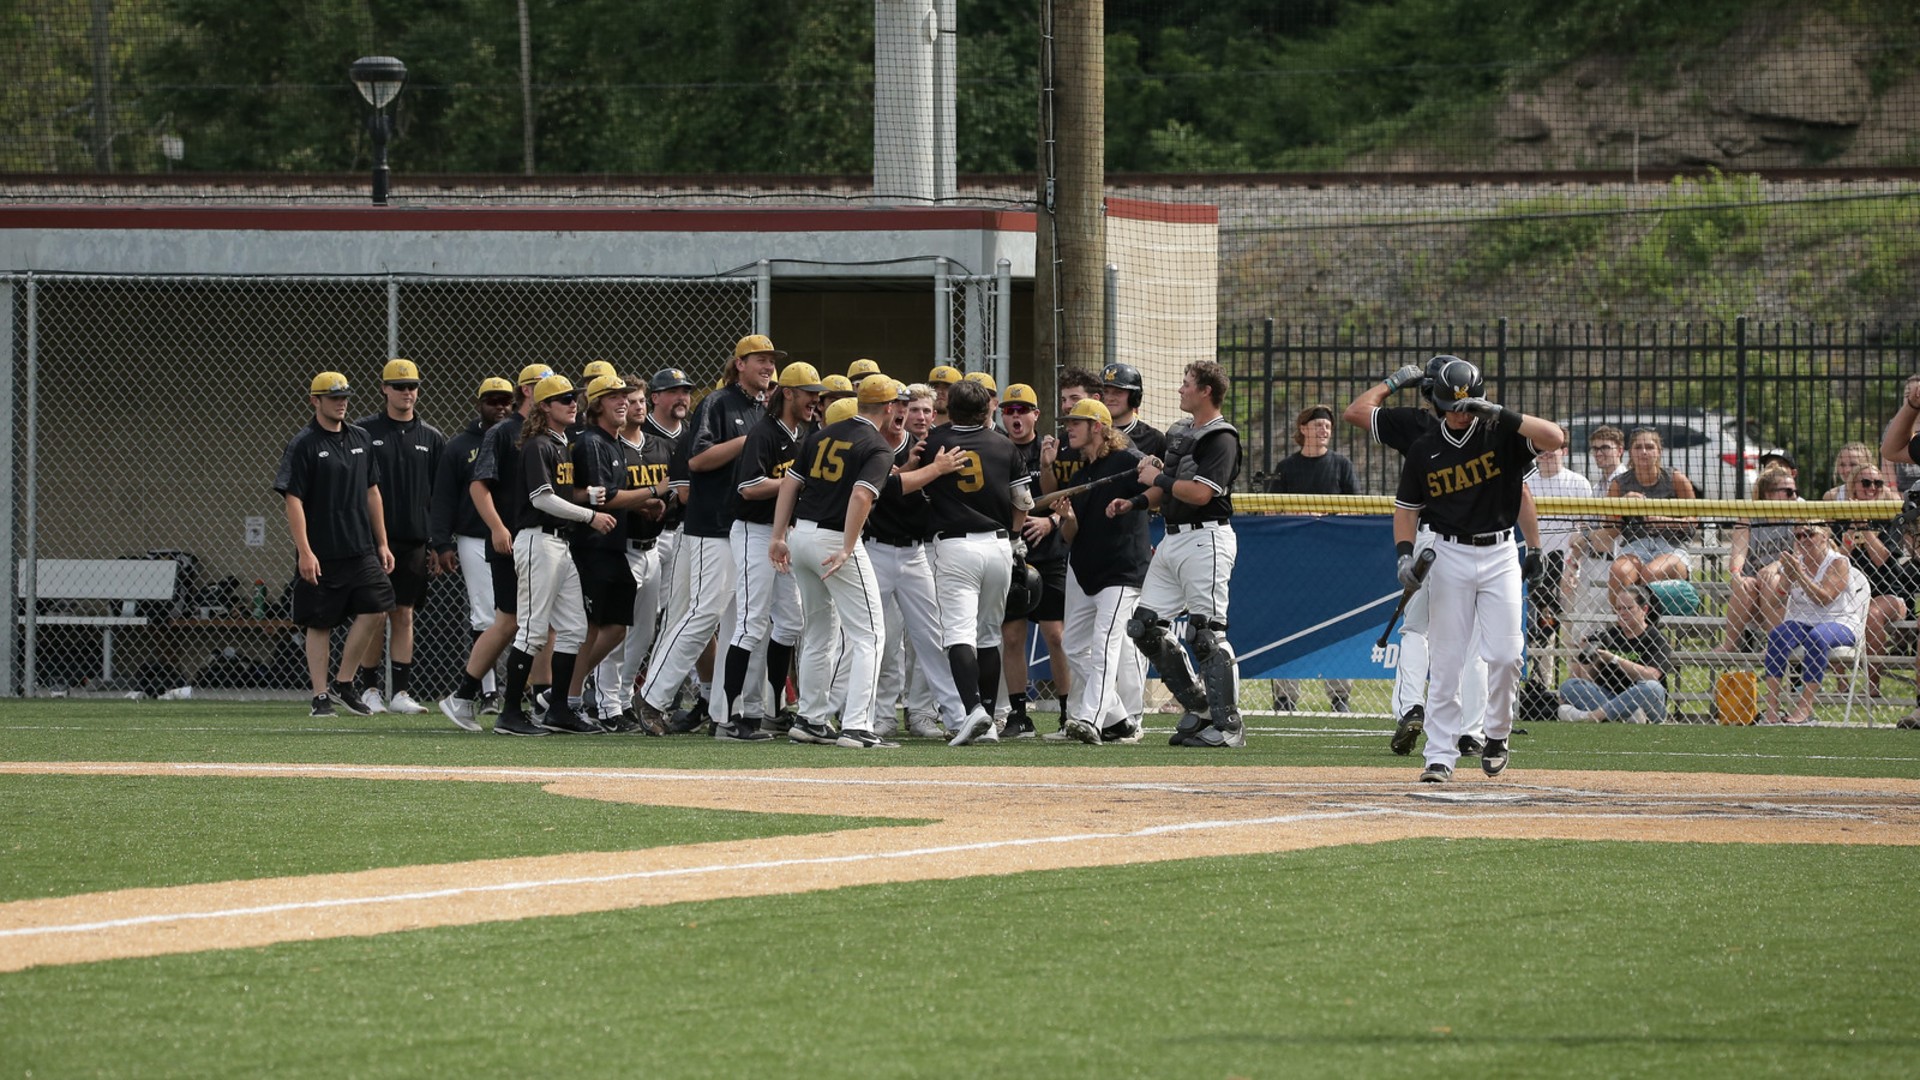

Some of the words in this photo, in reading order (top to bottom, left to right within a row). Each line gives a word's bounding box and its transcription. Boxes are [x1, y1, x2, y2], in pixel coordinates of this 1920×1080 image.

[626, 463, 668, 487] TATE
[809, 436, 854, 482] 15
[957, 450, 985, 493] 9
[1427, 450, 1501, 498] STATE
